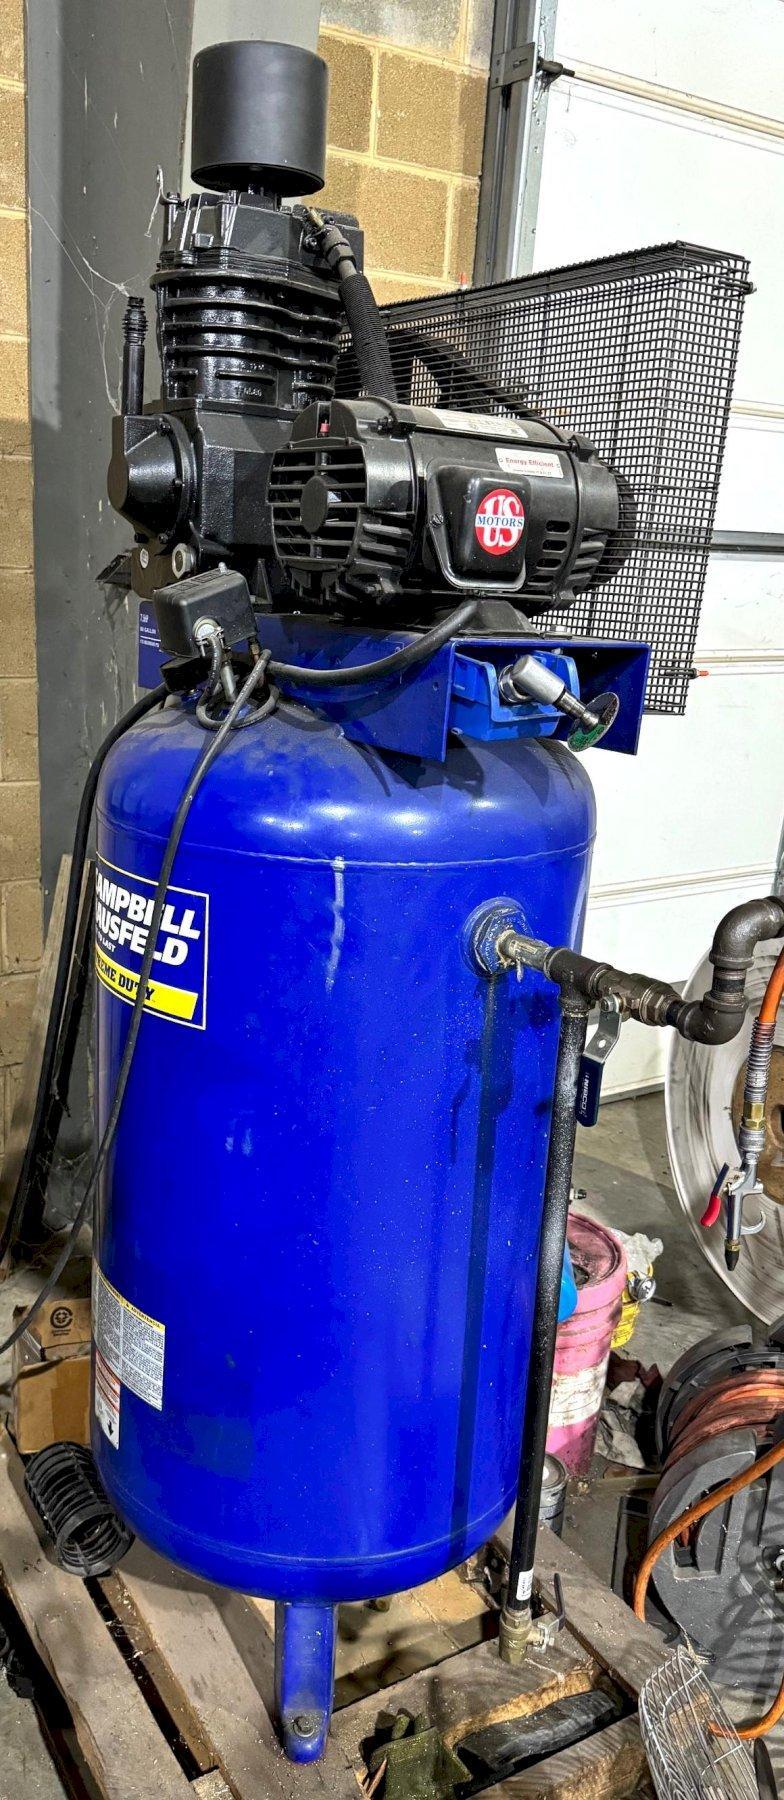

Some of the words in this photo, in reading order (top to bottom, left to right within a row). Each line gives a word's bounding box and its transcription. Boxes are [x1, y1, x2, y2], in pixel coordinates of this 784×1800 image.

[505, 457, 527, 466] Energy
[528, 459, 554, 468] Efficient
[477, 515, 523, 528] MOTORS
[483, 495, 520, 547] US
[96, 867, 201, 940] AMPBELL
